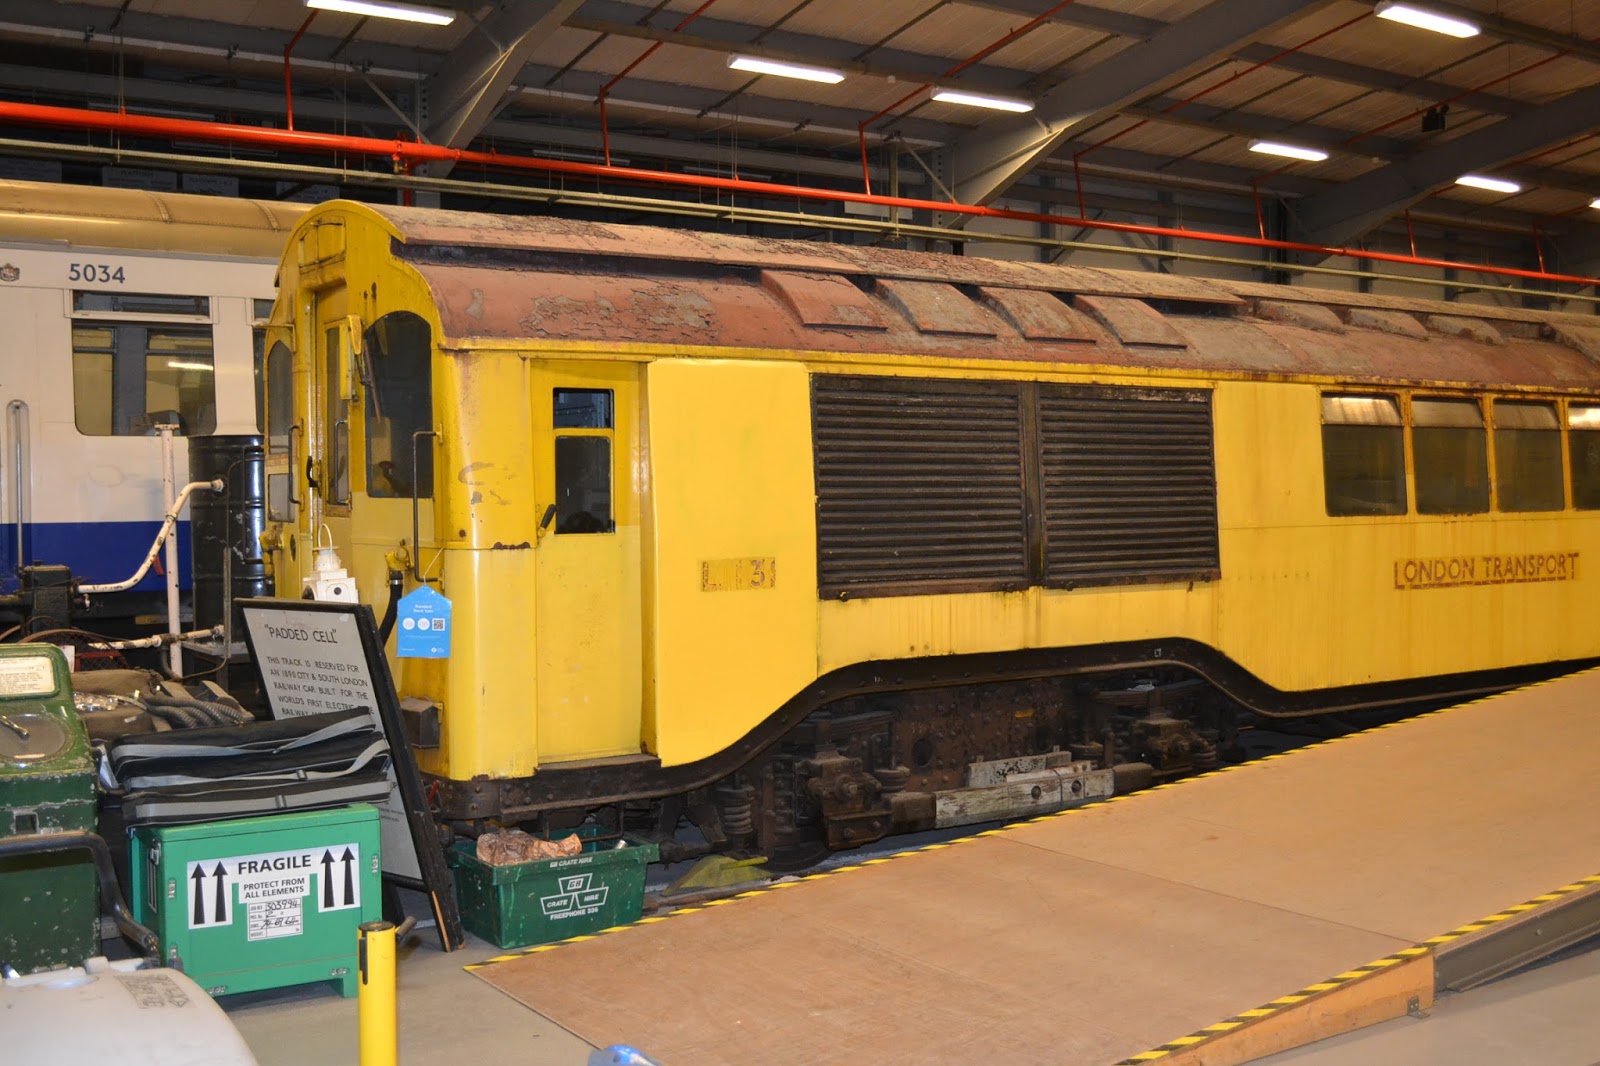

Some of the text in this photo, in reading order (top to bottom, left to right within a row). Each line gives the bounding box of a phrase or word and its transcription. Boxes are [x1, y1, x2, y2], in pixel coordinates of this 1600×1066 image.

[69, 263, 126, 284] 5034
[1394, 552, 1579, 590] LONDON TRANSPORT
[264, 624, 339, 644] "PADDED CELL"
[266, 656, 360, 673] THIS TRACK IS RESERVED FOR
[270, 669, 369, 687] AN 1890 CITY & SOUTH LONDON
[273, 681, 369, 700] RAILWAY CAR BUILT FOR THE
[307, 698, 323, 708] FIRST
[238, 854, 312, 875] FRAGILE
[558, 859, 578, 867] CRATE
[243, 877, 305, 891] PROTECT FROM
[245, 885, 305, 899] ALL ELEMENTS
[547, 893, 599, 908] CRATE HIRE
[550, 909, 586, 920] FREEPHONE
